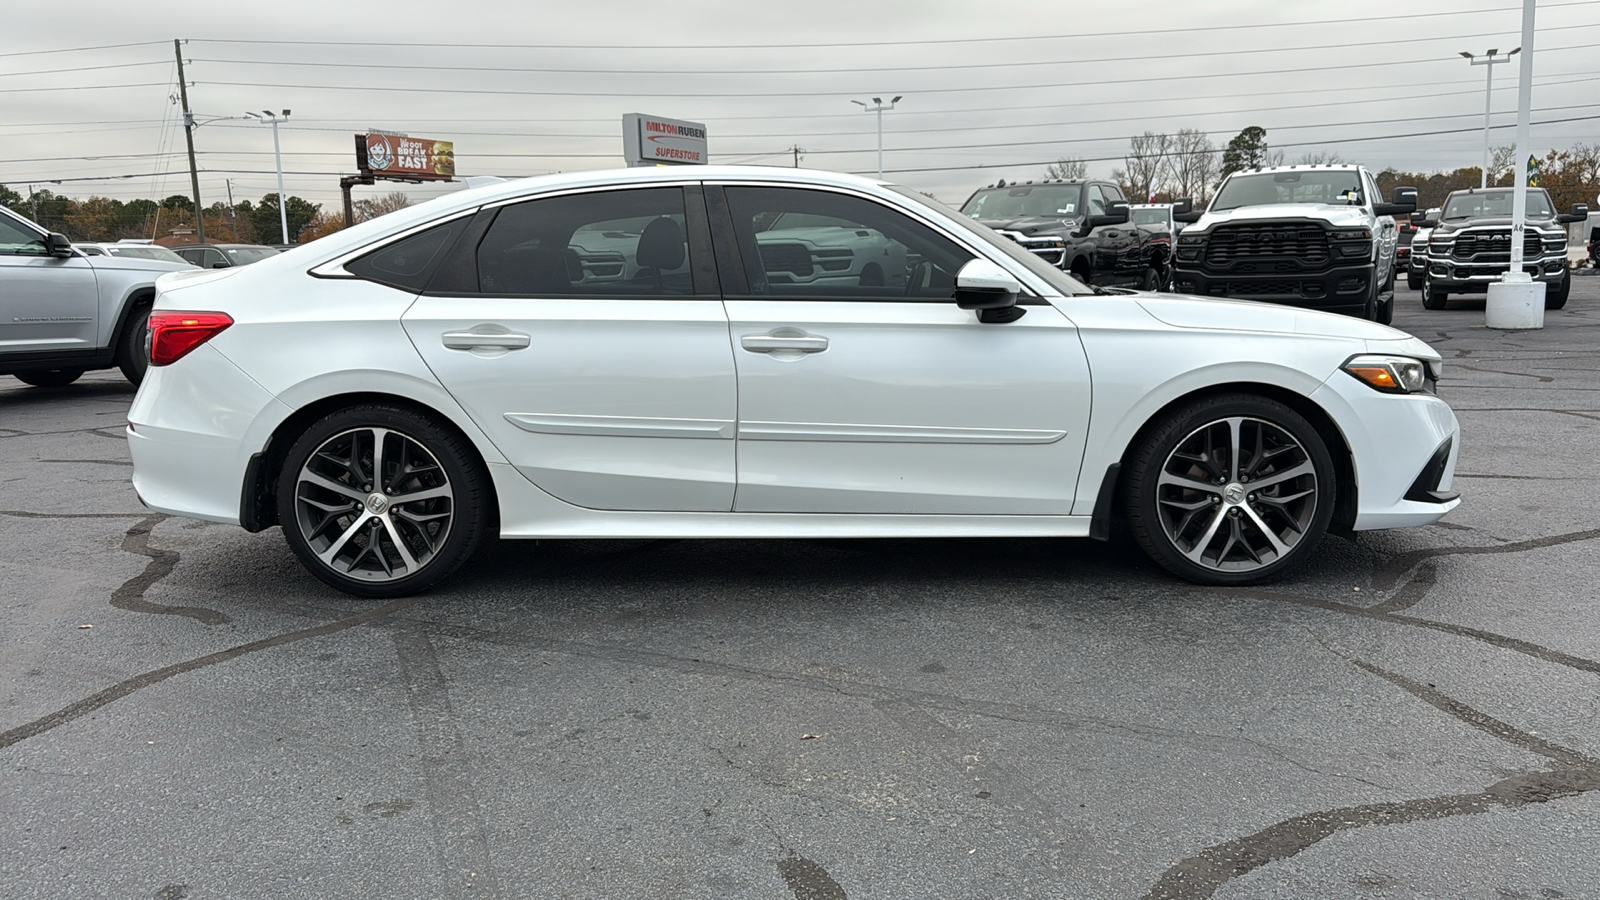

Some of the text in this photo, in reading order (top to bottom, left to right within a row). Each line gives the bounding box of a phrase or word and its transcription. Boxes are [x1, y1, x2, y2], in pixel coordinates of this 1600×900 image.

[646, 121, 705, 139] MILTON RUBEN
[397, 147, 427, 157] BREAK
[655, 147, 700, 160] SUPERSTORE
[398, 156, 428, 170] FAST
[1236, 231, 1298, 242] RAM
